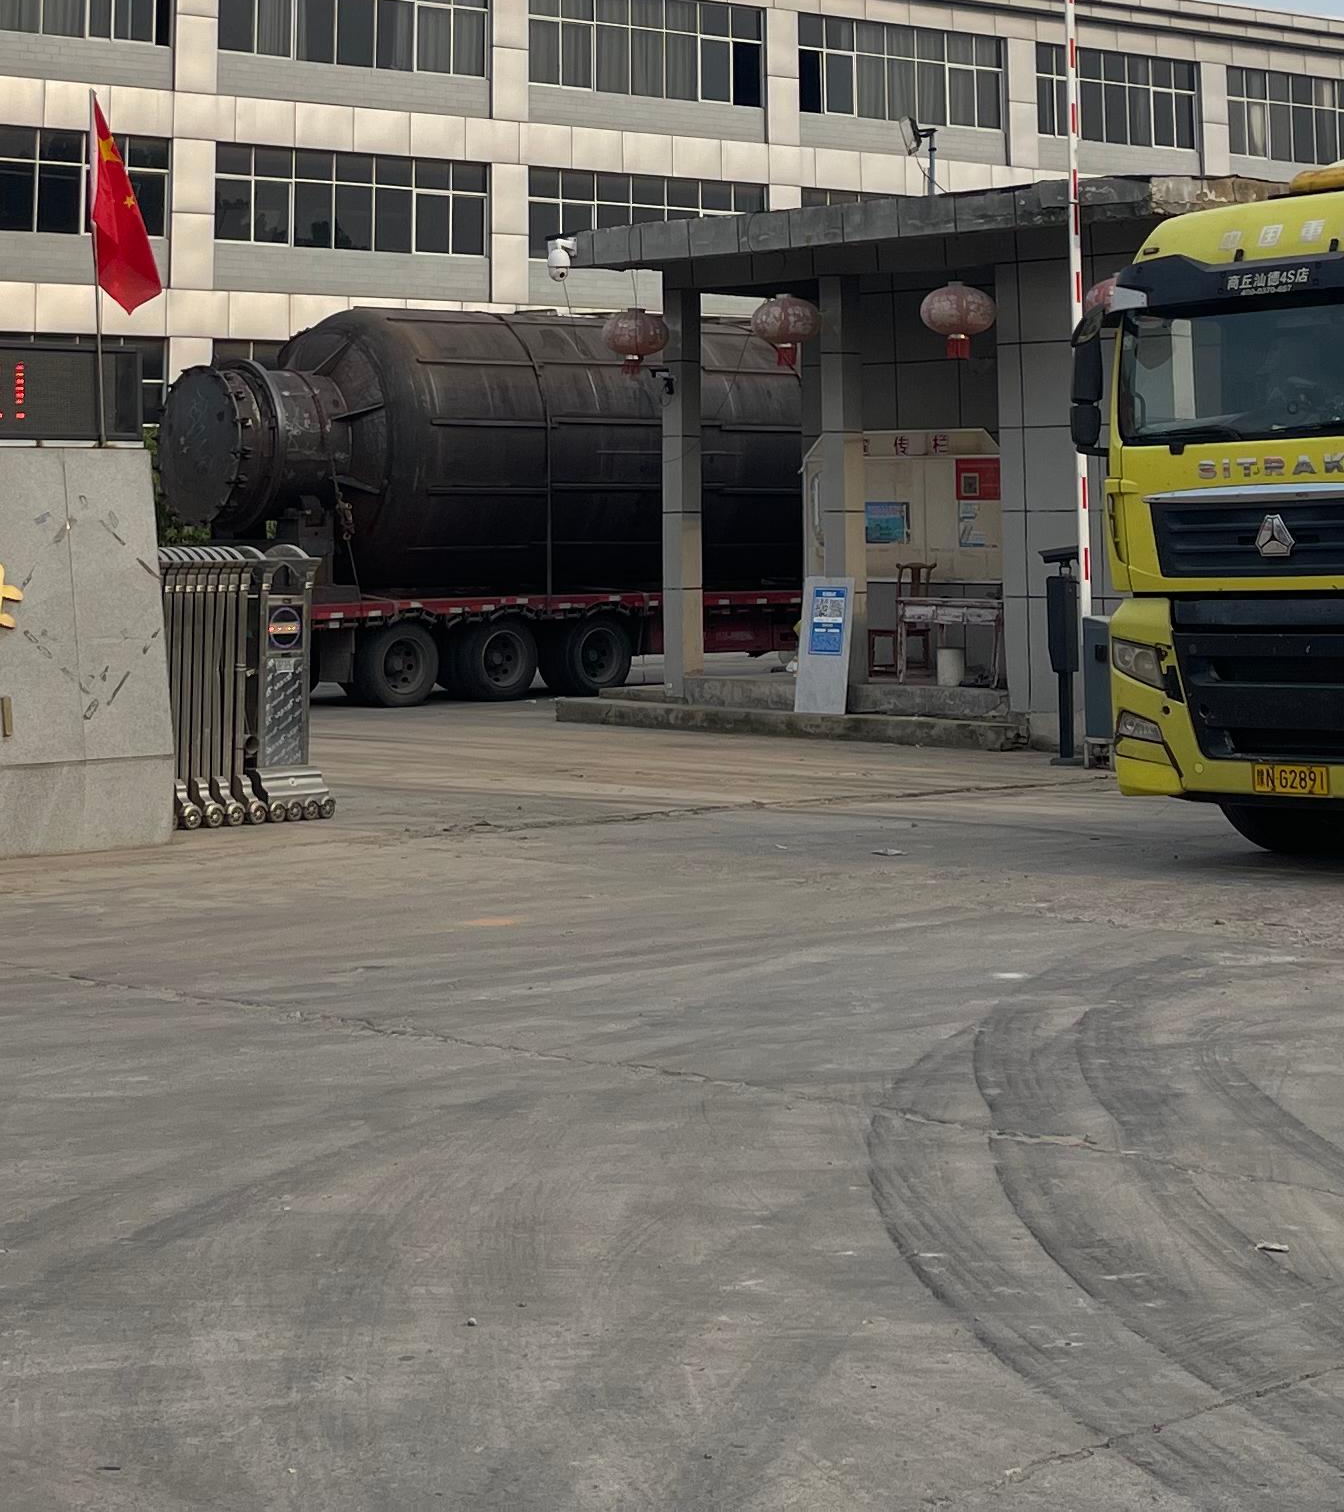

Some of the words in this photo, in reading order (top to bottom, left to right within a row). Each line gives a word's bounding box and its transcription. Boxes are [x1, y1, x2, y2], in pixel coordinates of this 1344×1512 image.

[1227, 267, 1310, 291] 商丘汕德4S店
